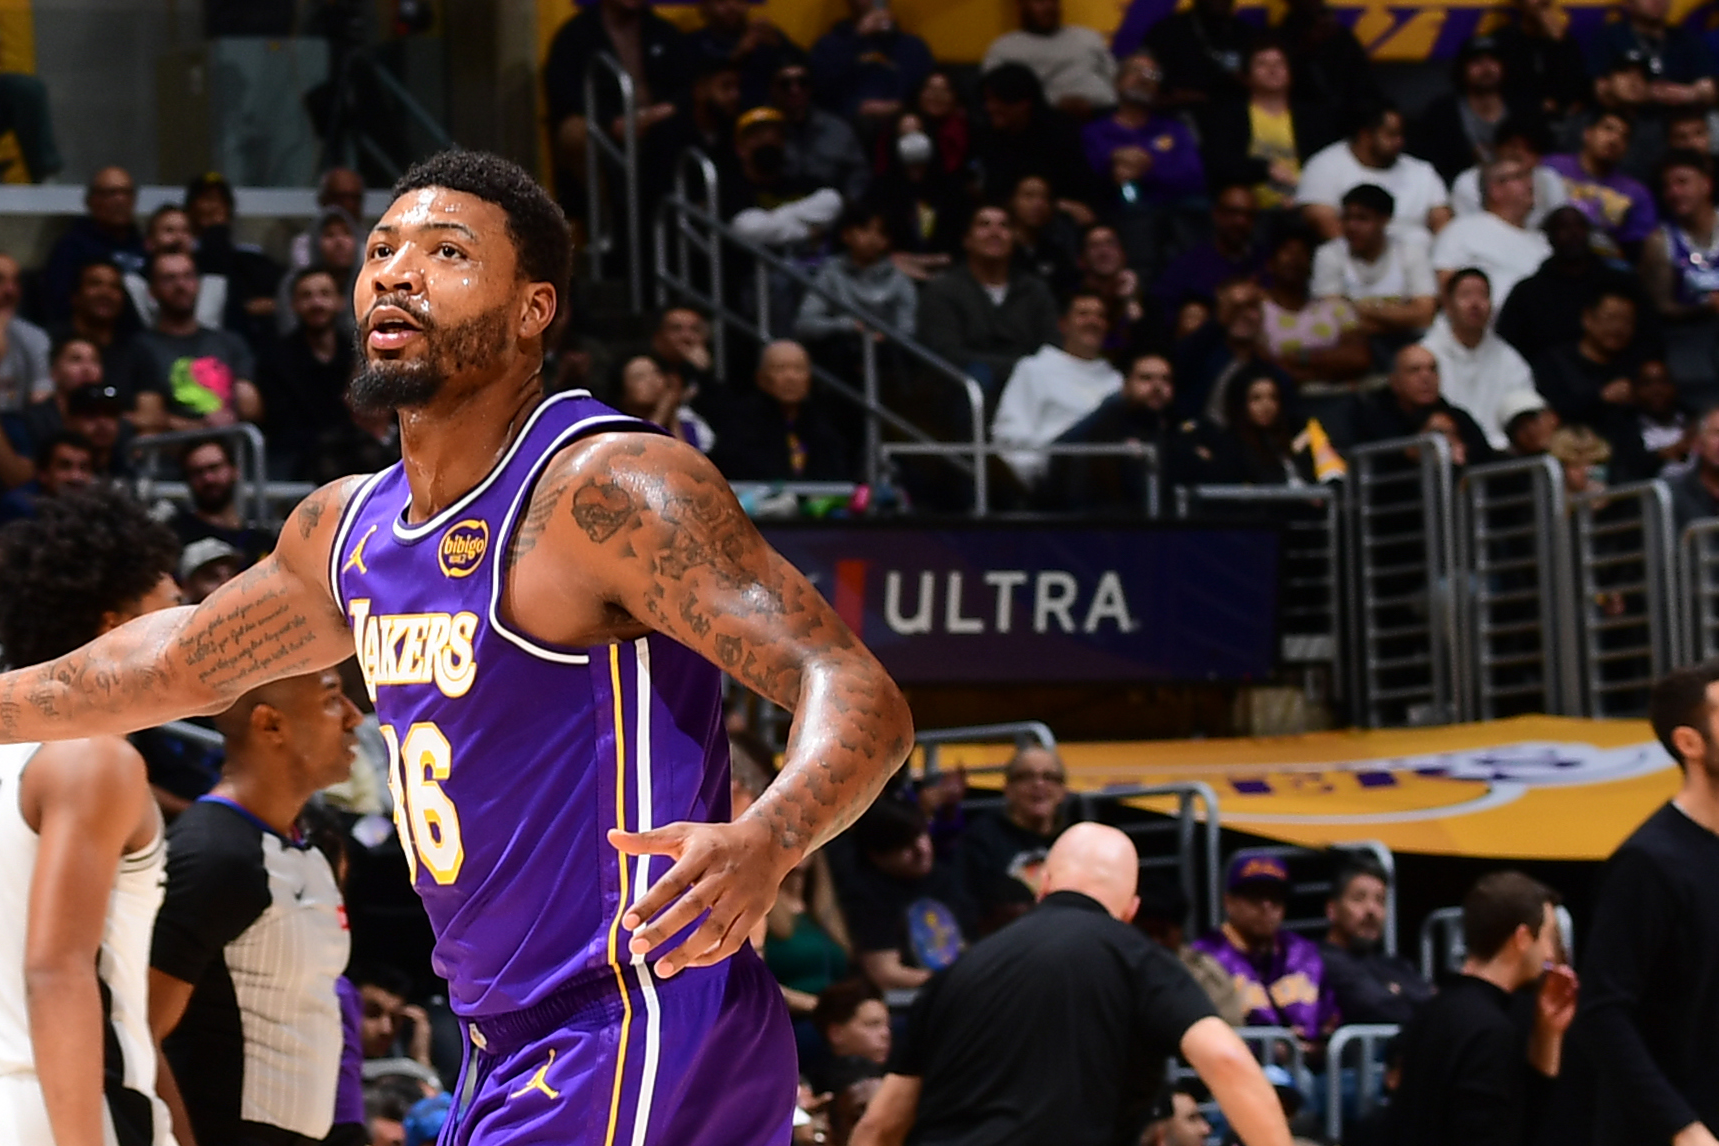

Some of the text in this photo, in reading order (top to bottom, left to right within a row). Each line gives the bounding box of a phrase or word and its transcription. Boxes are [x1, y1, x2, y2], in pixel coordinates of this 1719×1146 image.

[444, 534, 485, 560] bibigo
[885, 570, 1132, 636] ULTRA
[349, 598, 479, 703] LAKERS
